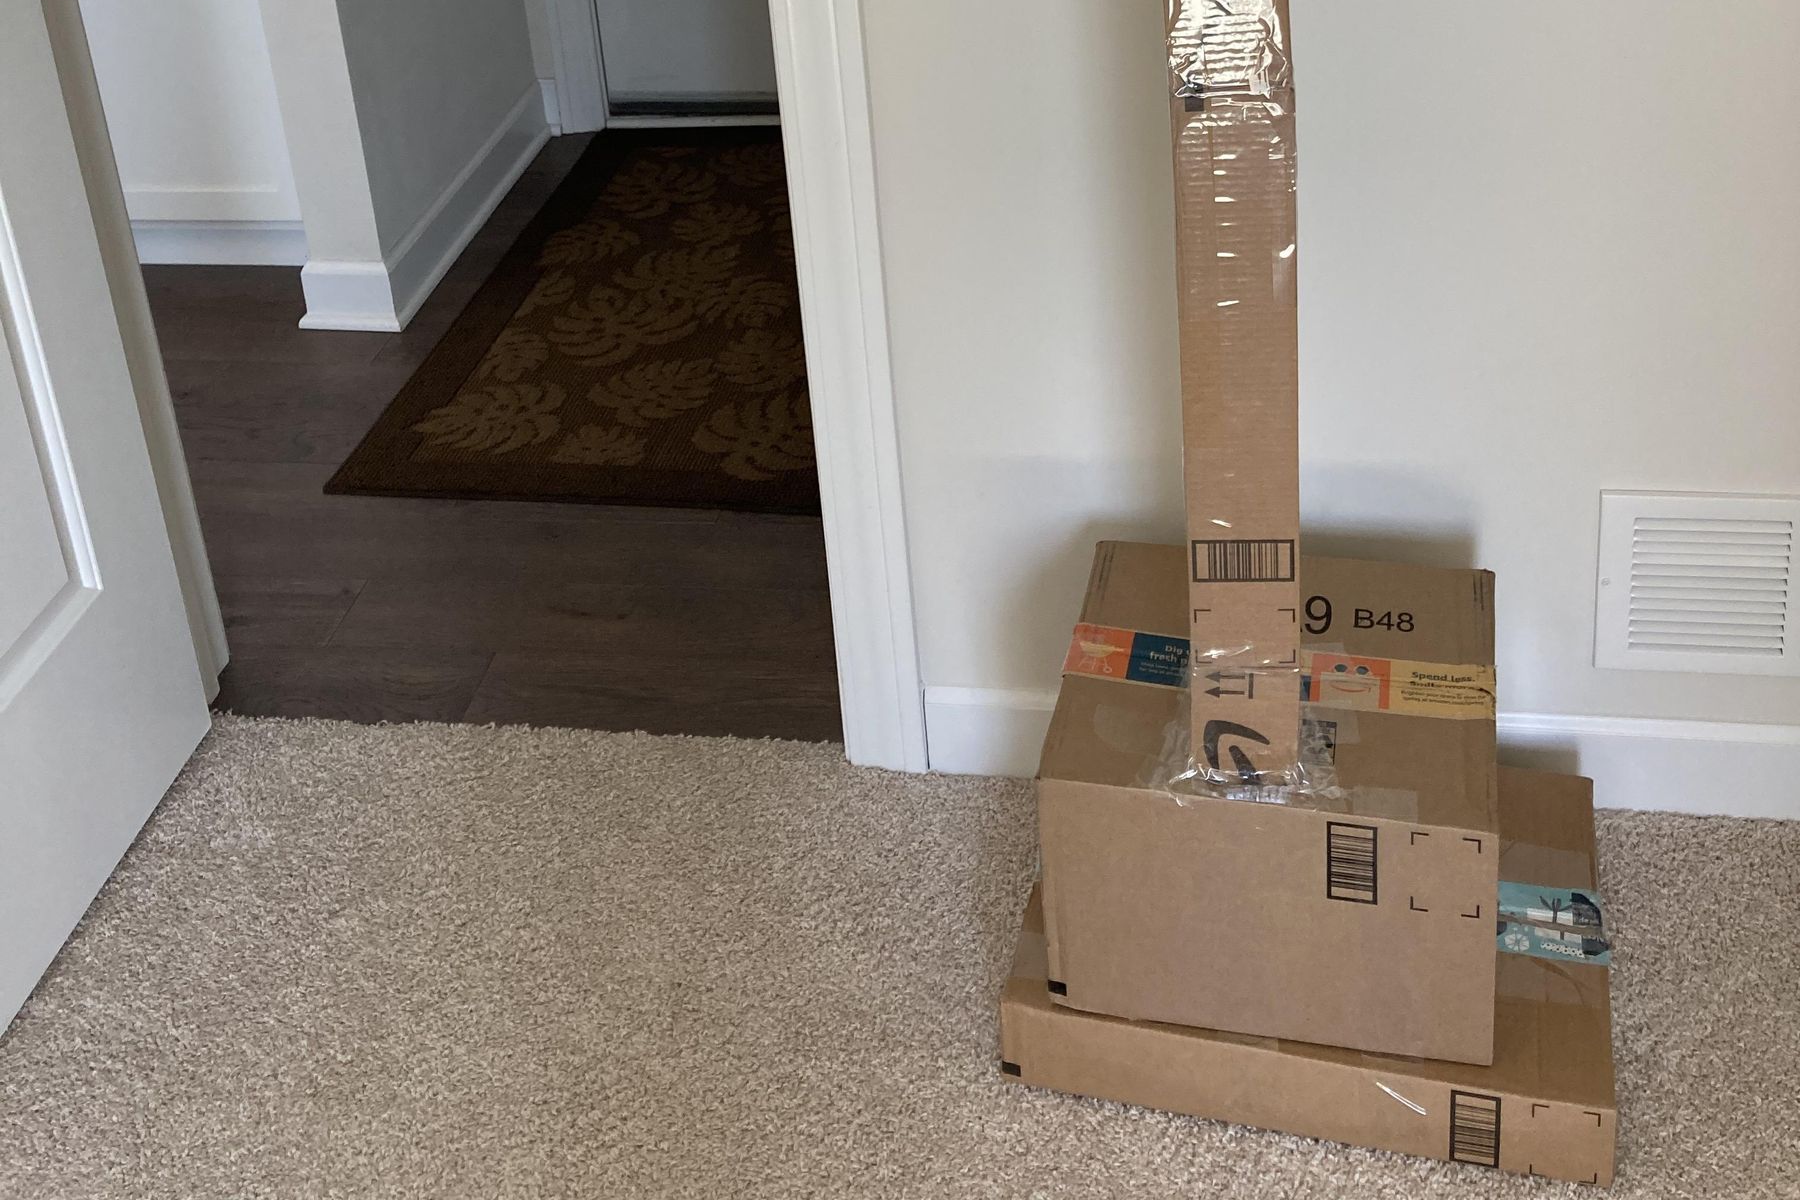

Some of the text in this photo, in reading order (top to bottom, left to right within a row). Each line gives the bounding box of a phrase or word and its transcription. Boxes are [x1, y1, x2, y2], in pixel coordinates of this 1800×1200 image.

[1300, 595, 1415, 634] 9 B48
[1411, 671, 1448, 681] Spend
